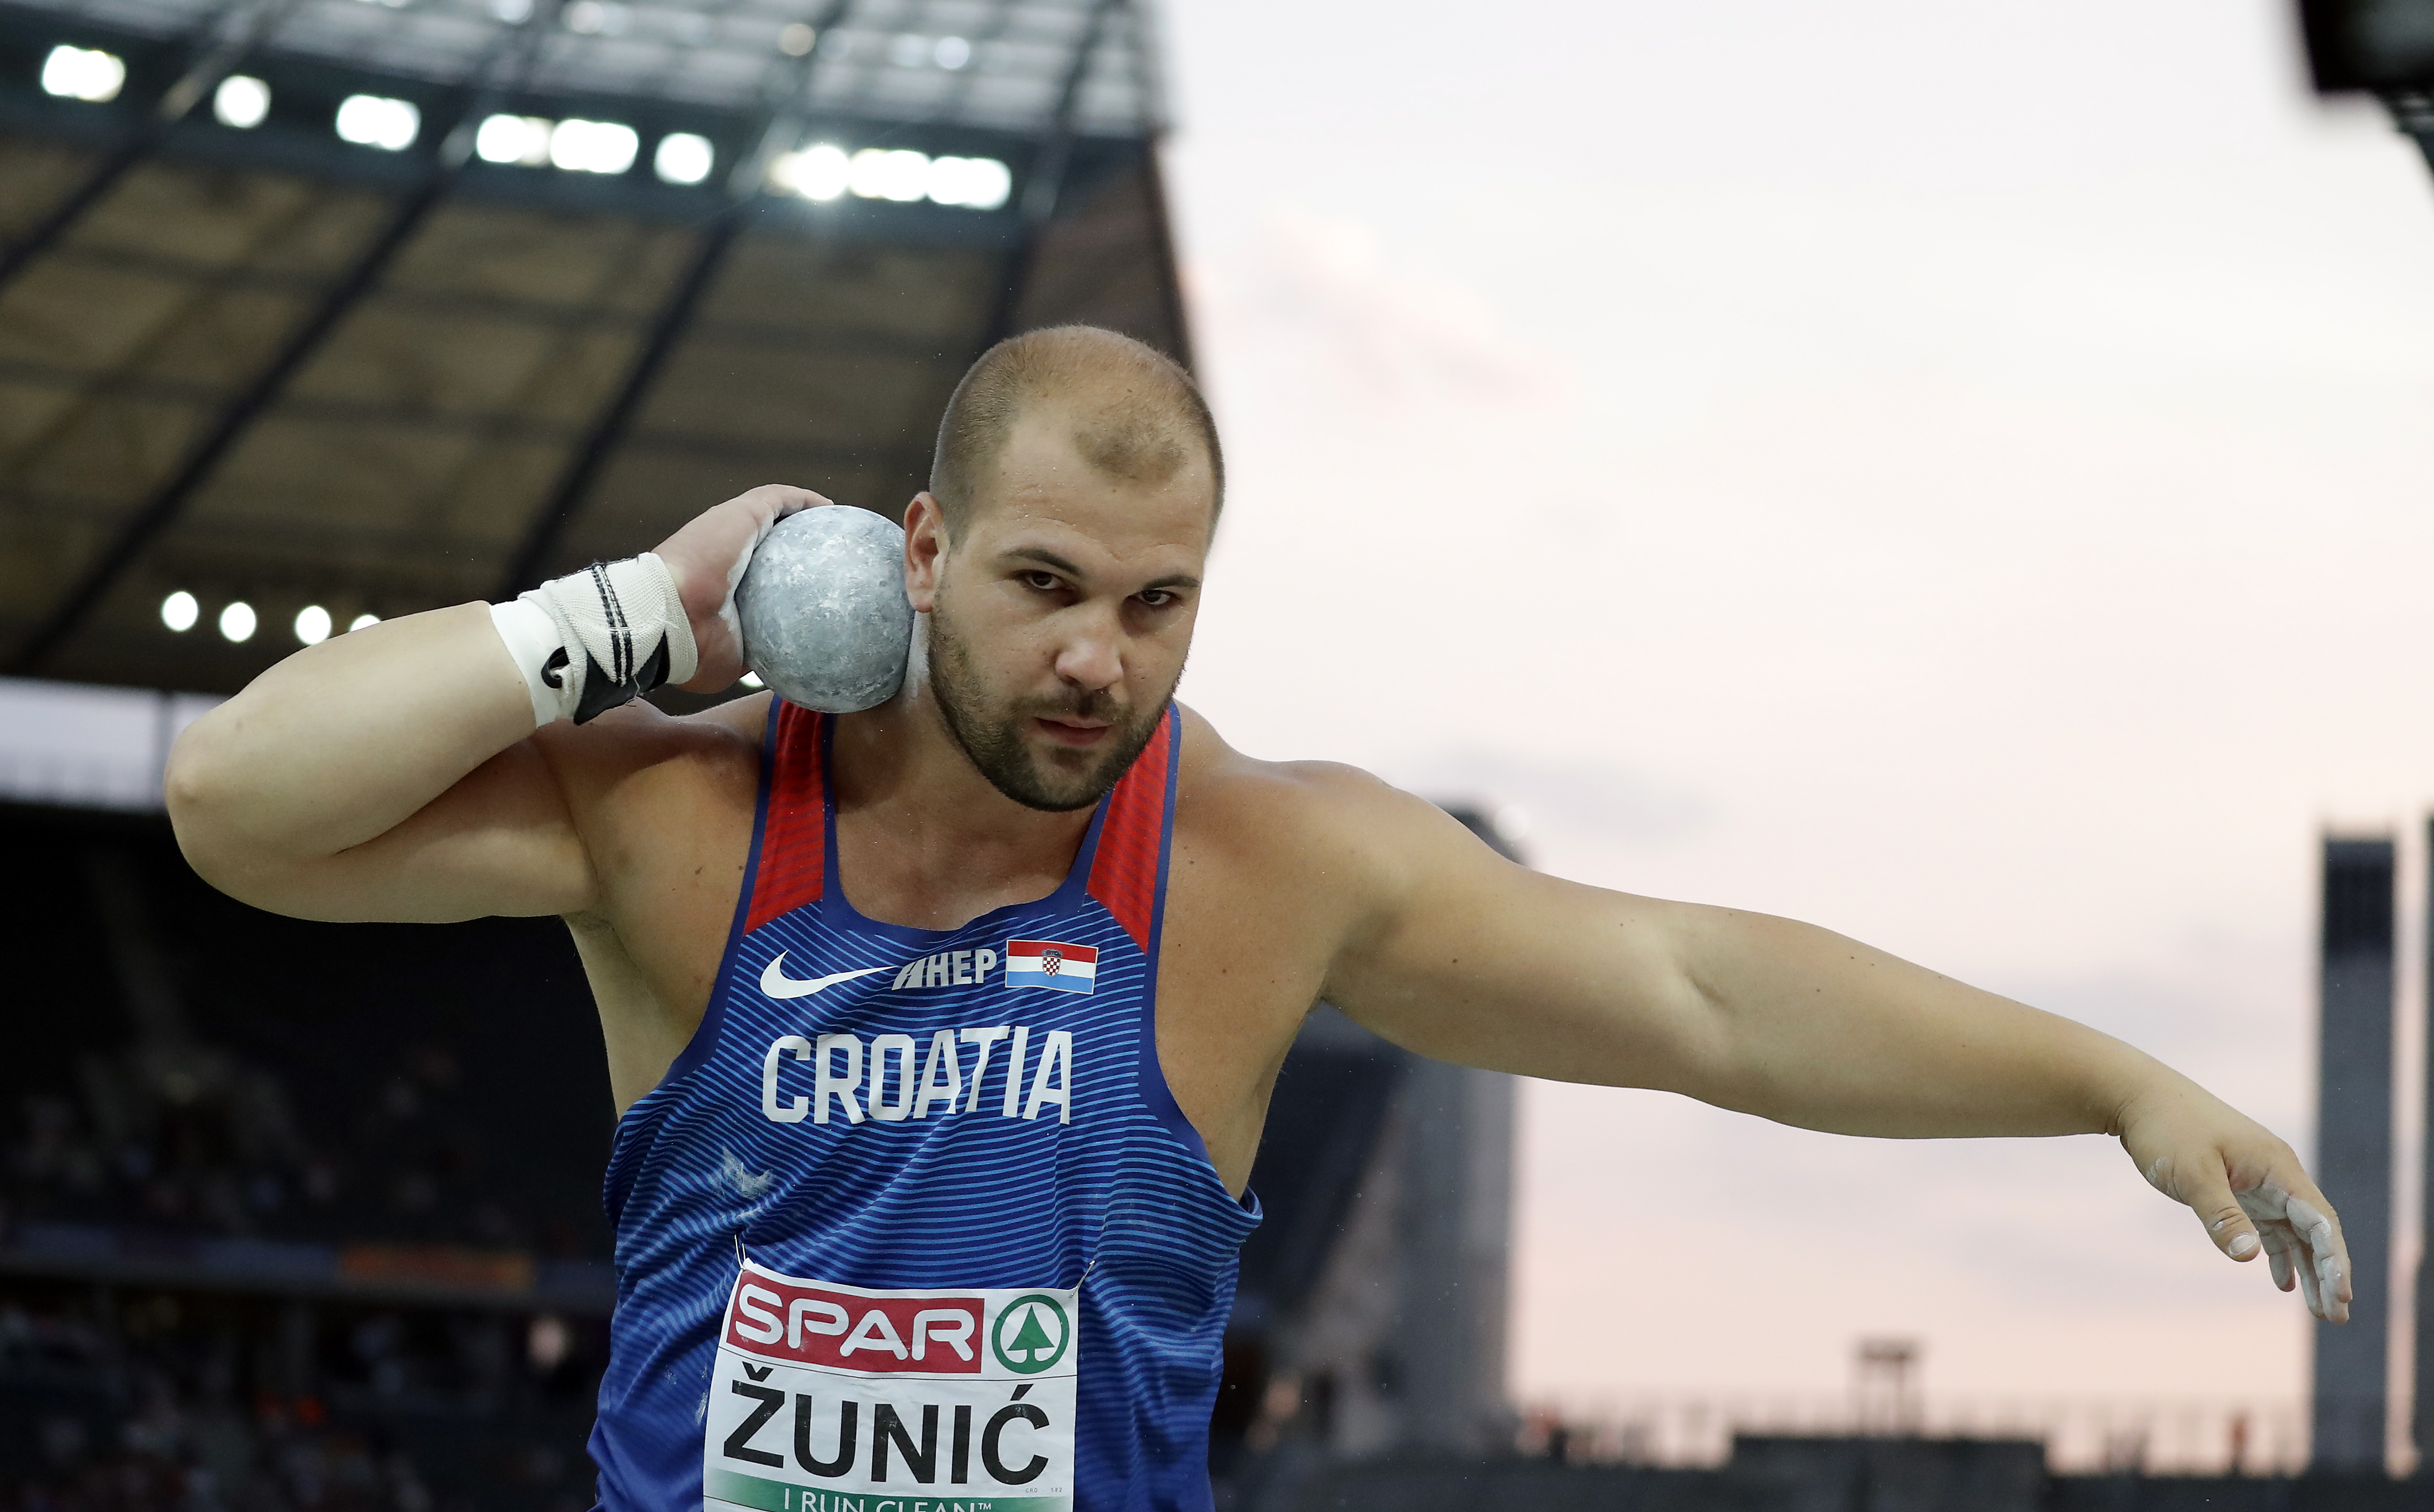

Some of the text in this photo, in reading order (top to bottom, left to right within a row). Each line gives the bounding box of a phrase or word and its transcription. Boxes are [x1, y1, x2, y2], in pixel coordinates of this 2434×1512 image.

[762, 1025, 1072, 1125] CROATIA
[735, 1283, 976, 1362] SPAR
[723, 1361, 1050, 1485] ŽUNIĆ
[784, 1488, 790, 1510] I
[801, 1491, 865, 1512] RUN
